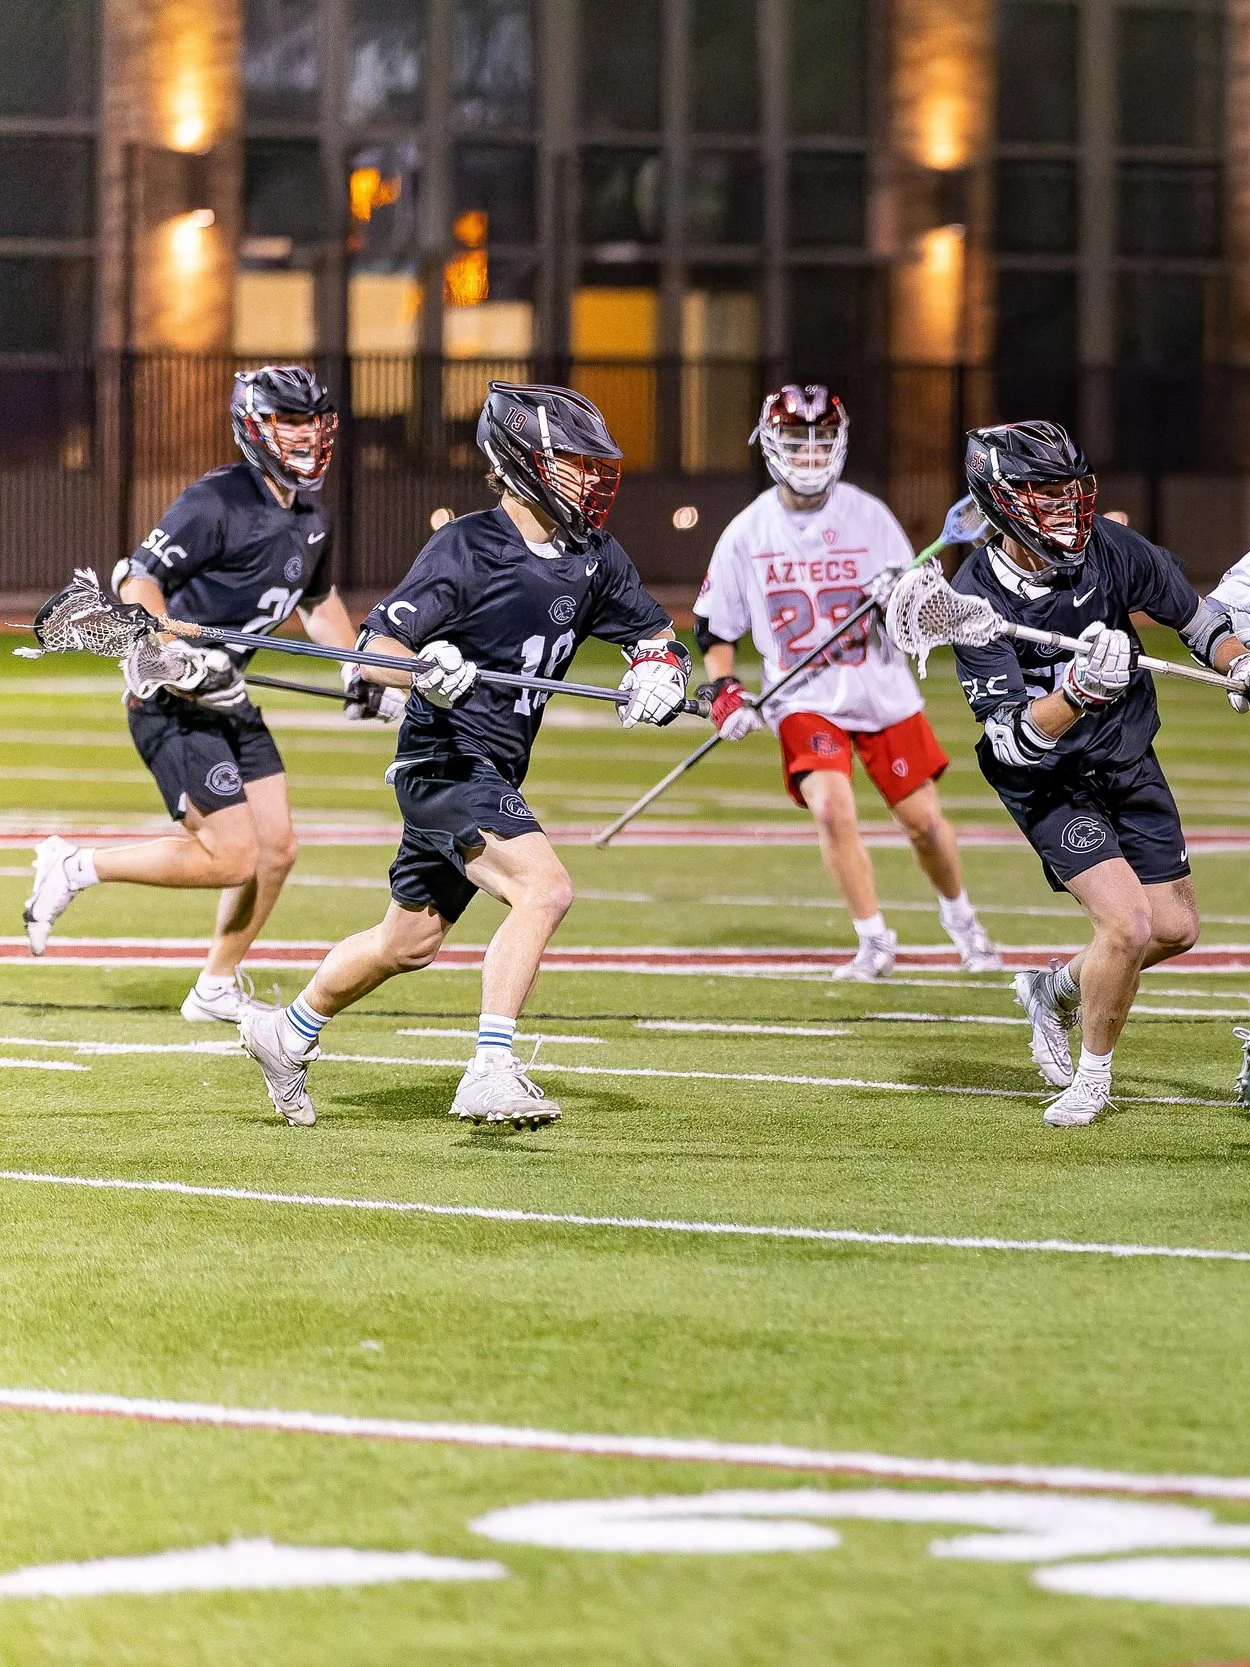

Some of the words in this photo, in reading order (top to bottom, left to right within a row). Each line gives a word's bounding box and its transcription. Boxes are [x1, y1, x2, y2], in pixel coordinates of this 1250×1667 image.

[503, 406, 528, 433] 19
[970, 448, 989, 474] 55
[140, 527, 188, 568] SLC
[766, 560, 857, 586] AZTECS
[637, 650, 669, 660] STX
